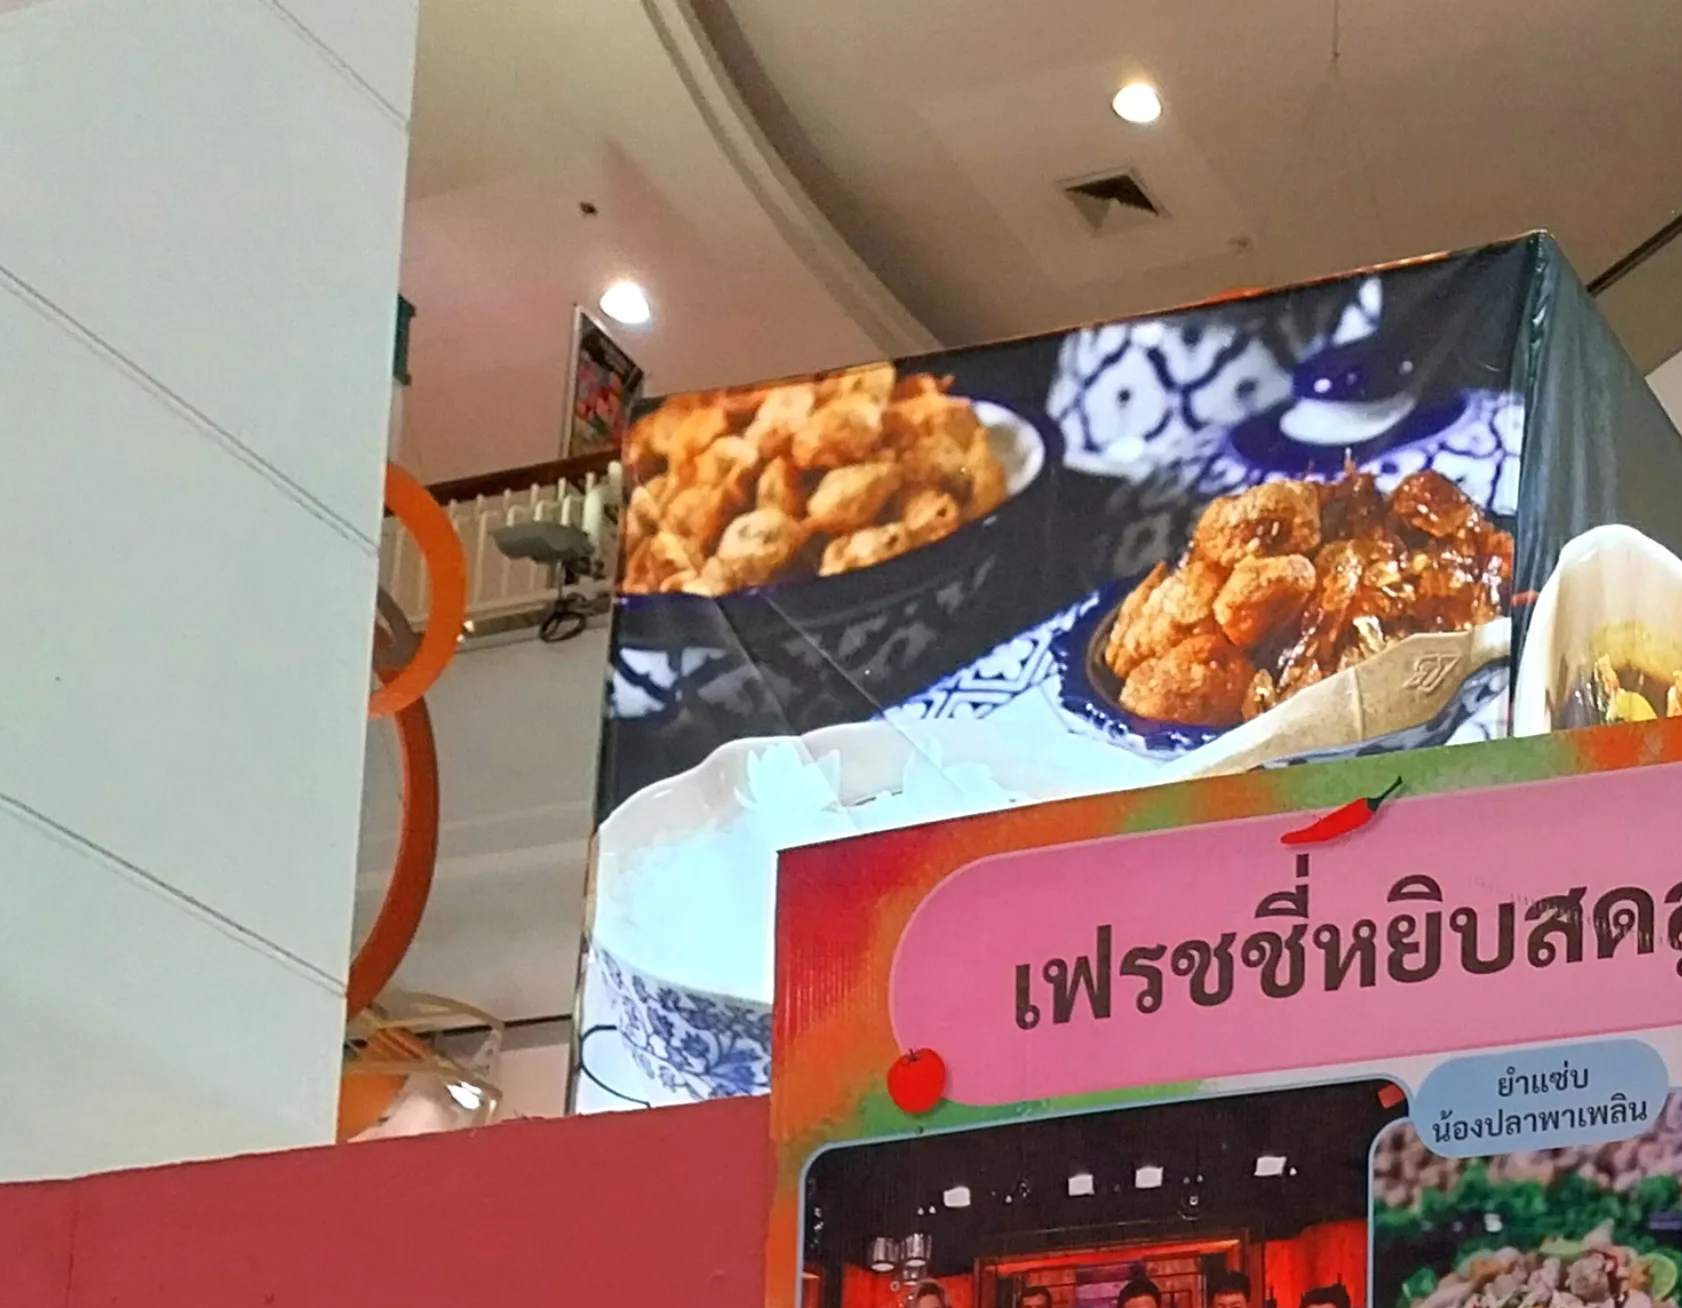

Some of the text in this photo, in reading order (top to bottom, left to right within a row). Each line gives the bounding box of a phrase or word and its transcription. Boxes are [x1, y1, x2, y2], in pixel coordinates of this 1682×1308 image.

[1497, 1060, 1589, 1098] ยำแซ่บ
[1432, 1093, 1648, 1144] น้องปลาพาเพลิน
